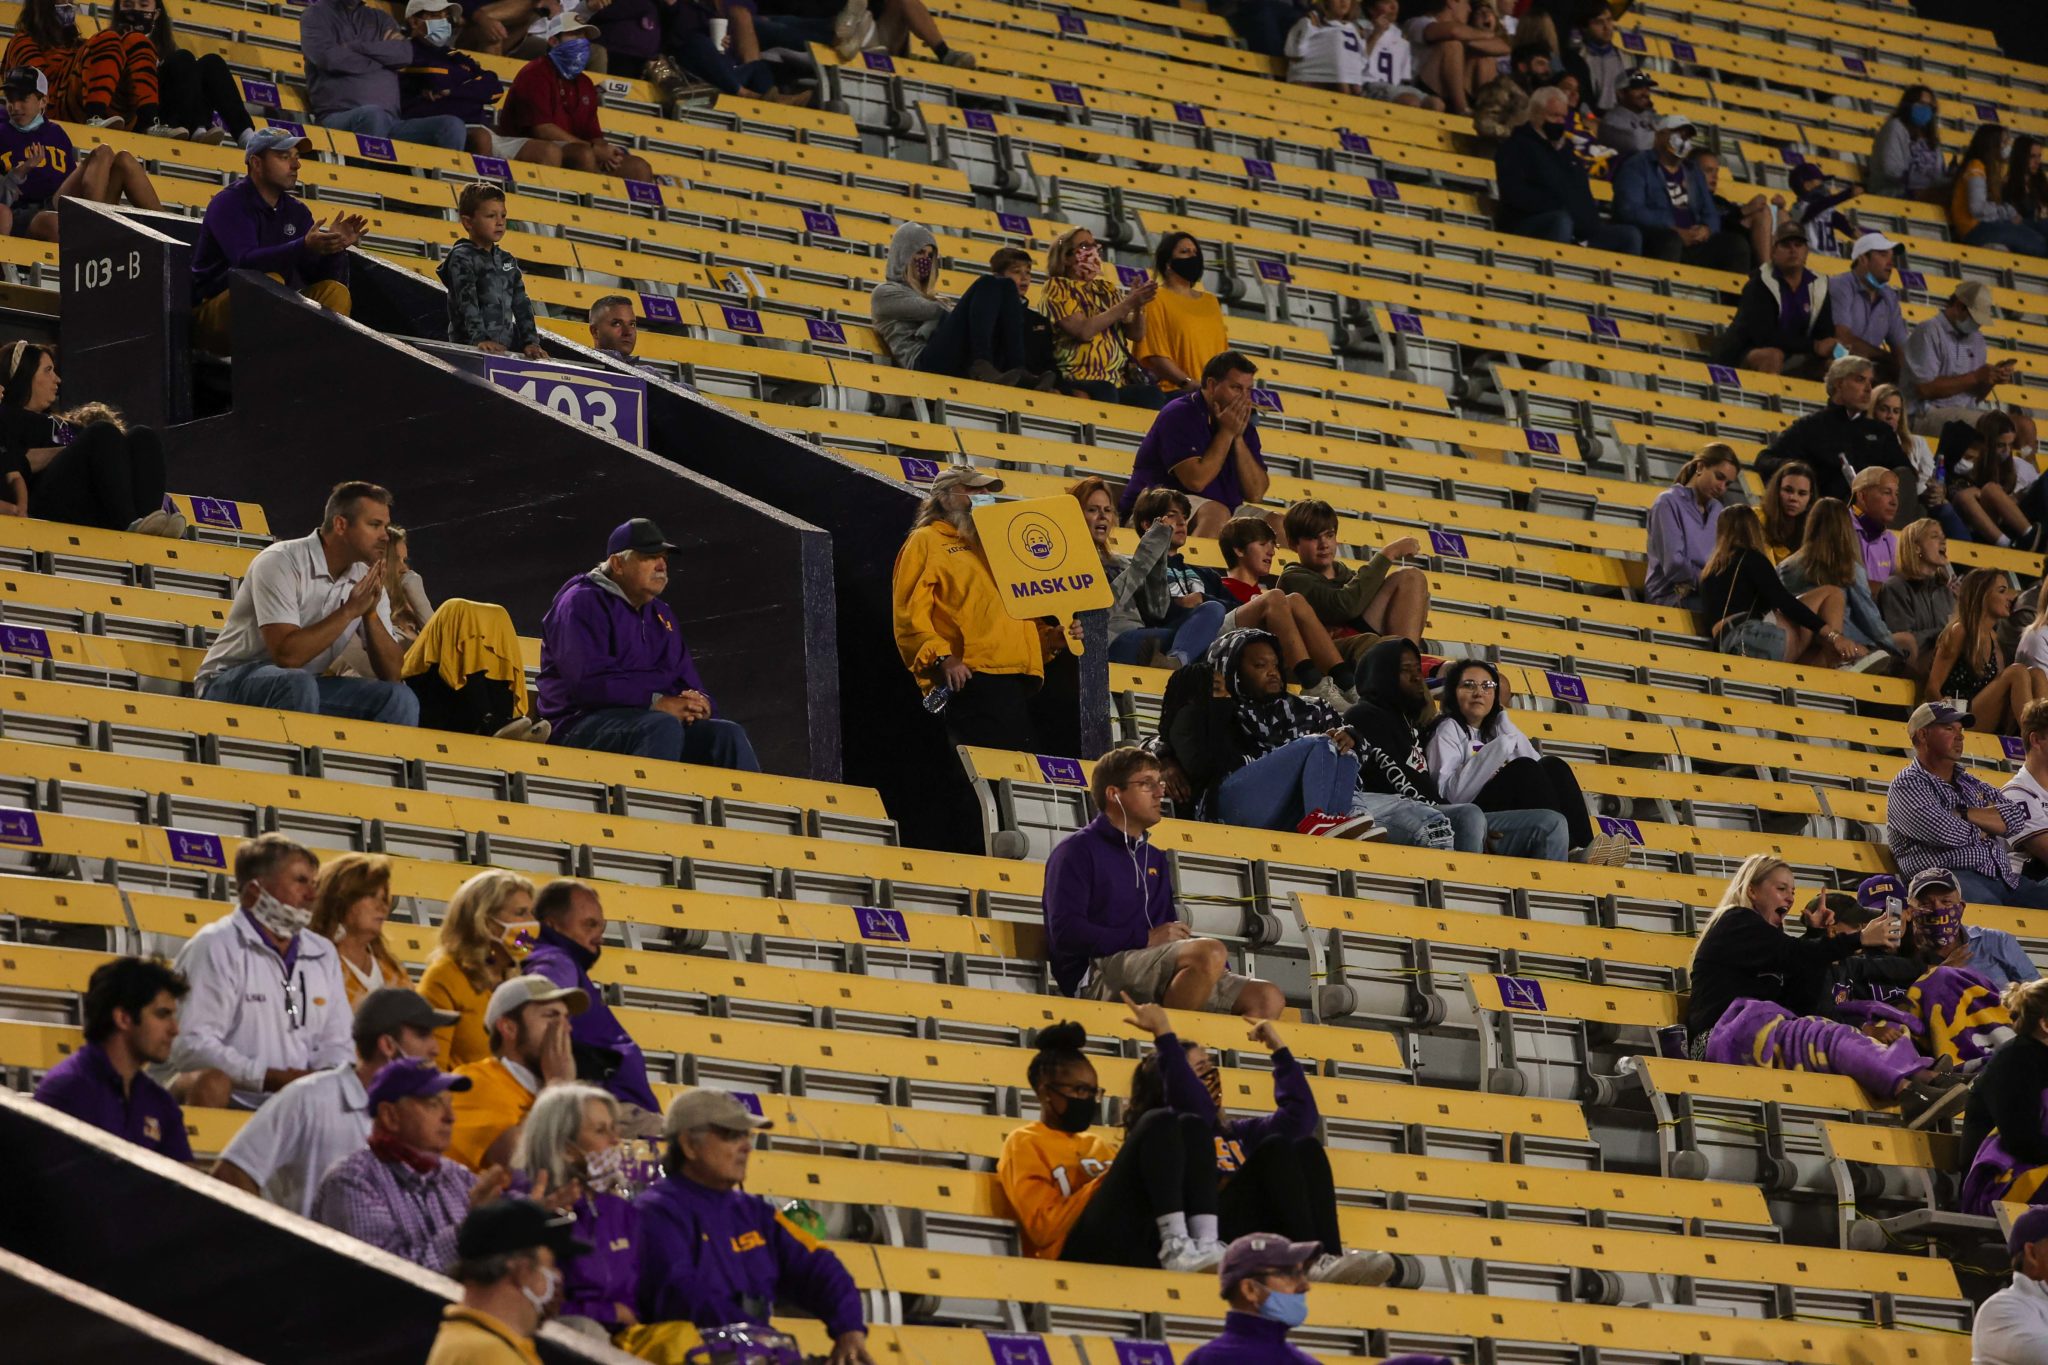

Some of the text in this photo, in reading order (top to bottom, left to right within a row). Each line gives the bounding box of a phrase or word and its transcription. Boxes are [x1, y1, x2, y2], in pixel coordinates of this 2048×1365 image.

[608, 82, 629, 93] LSU
[75, 251, 141, 293] 103-B
[1033, 546, 1047, 555] LSU
[1011, 573, 1094, 598] MASK UP
[1868, 883, 1894, 896] LSU
